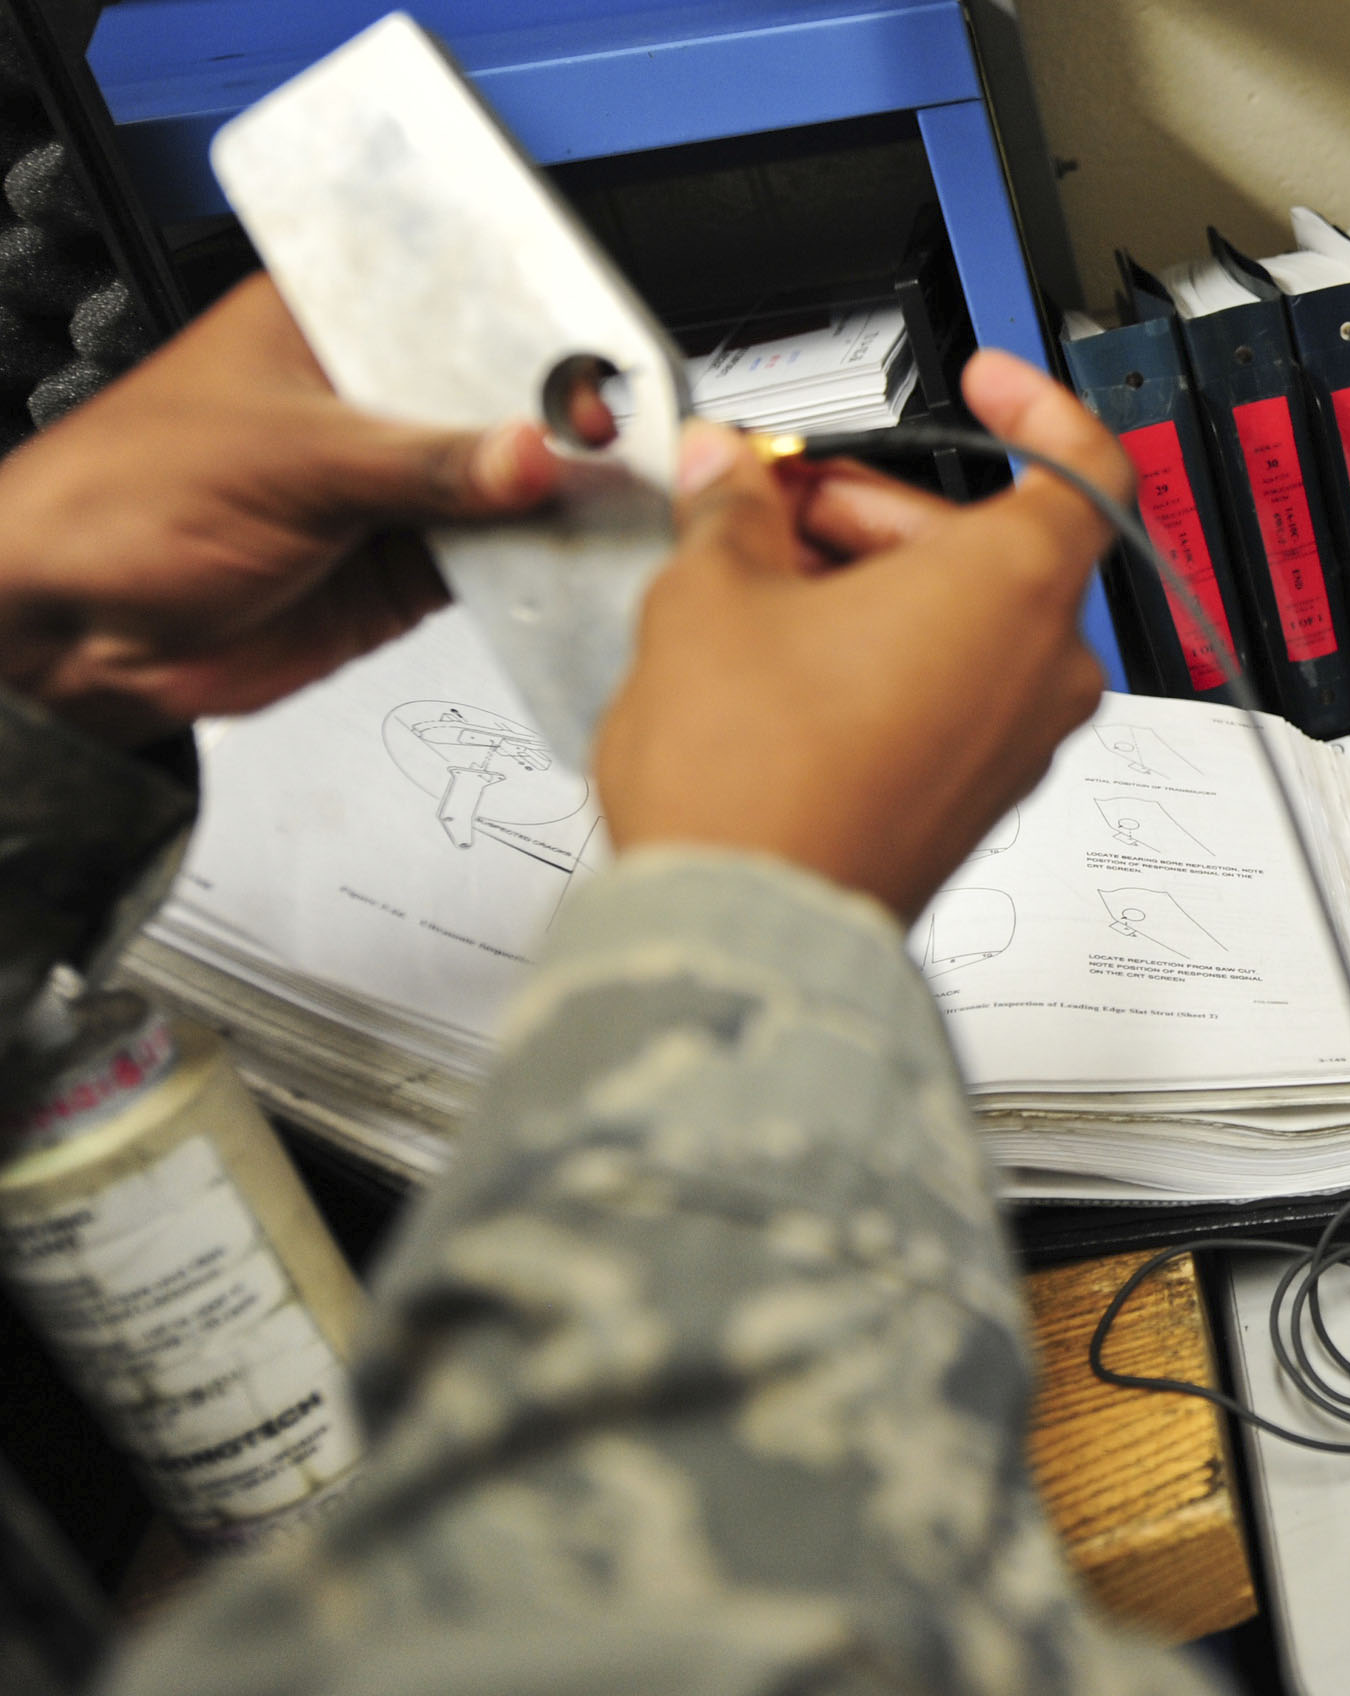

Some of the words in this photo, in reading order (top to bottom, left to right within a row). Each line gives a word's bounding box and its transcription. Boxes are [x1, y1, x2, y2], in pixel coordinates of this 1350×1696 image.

[1086, 851, 1119, 859] LOCATE
[1121, 855, 1158, 864] BEARING
[1086, 857, 1126, 866] POSITION
[1142, 863, 1187, 874] RESPONSE
[1189, 869, 1220, 877] SIGNAL
[1088, 954, 1125, 962] LOCATE
[1127, 958, 1184, 968] REFLECTION
[1089, 961, 1115, 969] NOTE
[1116, 964, 1160, 973] POSITION
[1177, 970, 1228, 979] RESPONSE
[1230, 974, 1264, 982] SIGNAL
[1148, 974, 1186, 983] SCREEN
